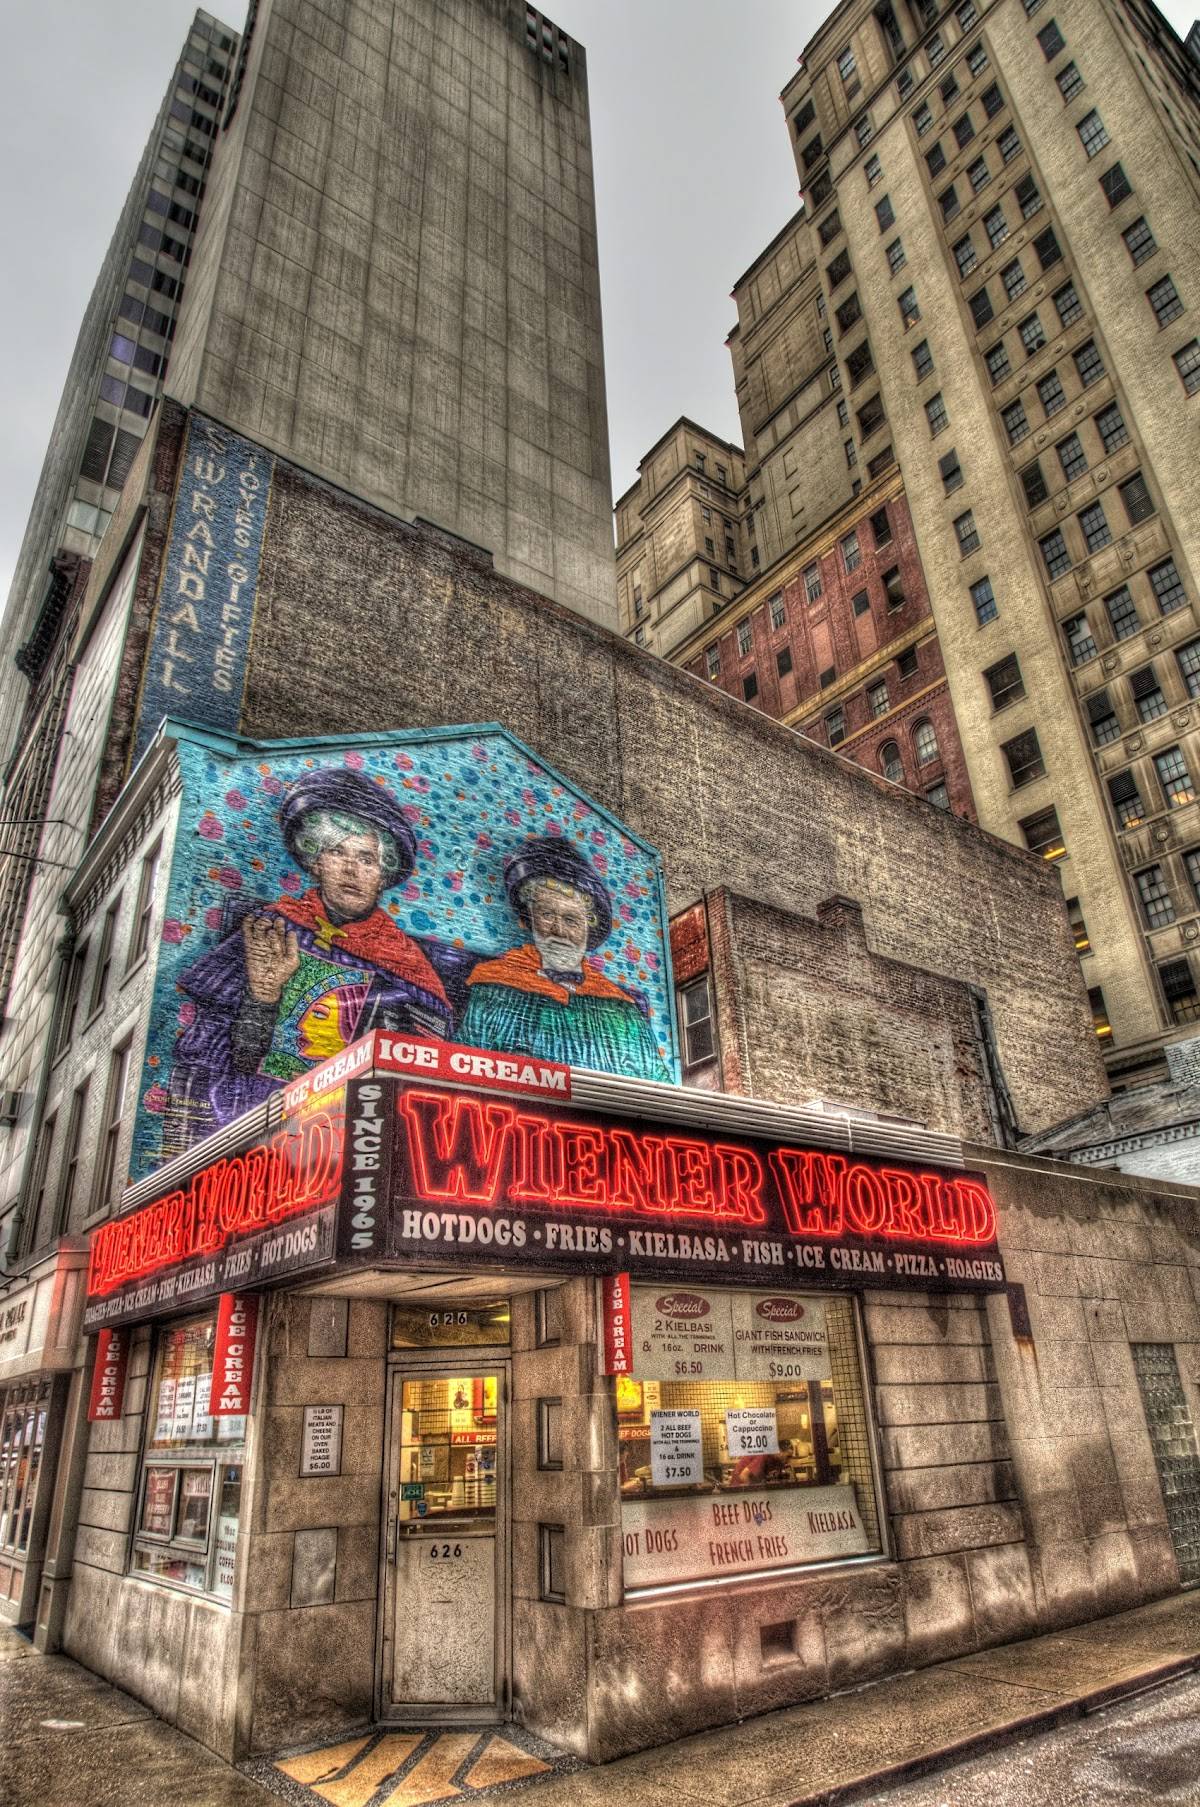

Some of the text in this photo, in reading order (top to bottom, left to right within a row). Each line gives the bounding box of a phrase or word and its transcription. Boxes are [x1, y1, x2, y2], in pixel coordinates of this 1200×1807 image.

[161, 490, 217, 693] RANDALL
[285, 1040, 372, 1110] ICE CREAM
[379, 1039, 567, 1092] ICE CREAM
[351, 1085, 384, 1249] SINCE 1965
[400, 1090, 997, 1243] WIENER WORLD
[189, 1110, 346, 1252] WORLD
[401, 1210, 1004, 1282] HOTDOGS FRIES KIELBASA FISH ICE CREAM PIZZA HOAGIES
[123, 1292, 135, 1313] ICE
[135, 1284, 157, 1309] CREAM
[158, 1277, 176, 1302] FISH
[176, 1262, 216, 1296] KIELBASA
[224, 1248, 252, 1280] FRIES
[261, 1236, 285, 1268] HOT
[284, 1223, 318, 1259] DOGS
[228, 1300, 246, 1337] ICE
[430, 1312, 468, 1327] 626
[661, 1297, 704, 1317] Special
[761, 1301, 798, 1320] Special
[613, 1278, 627, 1371] ICE CREAM
[655, 1321, 713, 1333] 2 KIELBASI
[735, 1330, 826, 1342] GIANT FISH SANDWICH
[642, 1341, 652, 1352] &
[694, 1343, 725, 1353] DRINK
[751, 1346, 822, 1356] WITH FRENCH FRIES
[96, 1333, 120, 1416] ICE CREAM
[218, 1344, 244, 1409] CREAM
[675, 1361, 703, 1375] $6.50
[769, 1362, 802, 1378] $9.00
[742, 1411, 775, 1419] Chocolate
[455, 1435, 472, 1443] ALL
[733, 1425, 773, 1434] Cappuccino
[740, 1435, 768, 1449] $2.00
[665, 1467, 691, 1478] $7.50
[712, 1500, 773, 1527] BEEF DOGS
[807, 1510, 857, 1535] KIELBASA
[430, 1543, 462, 1558] 626
[645, 1528, 679, 1554] DOGS
[709, 1535, 788, 1566] FRENCH FRIES
